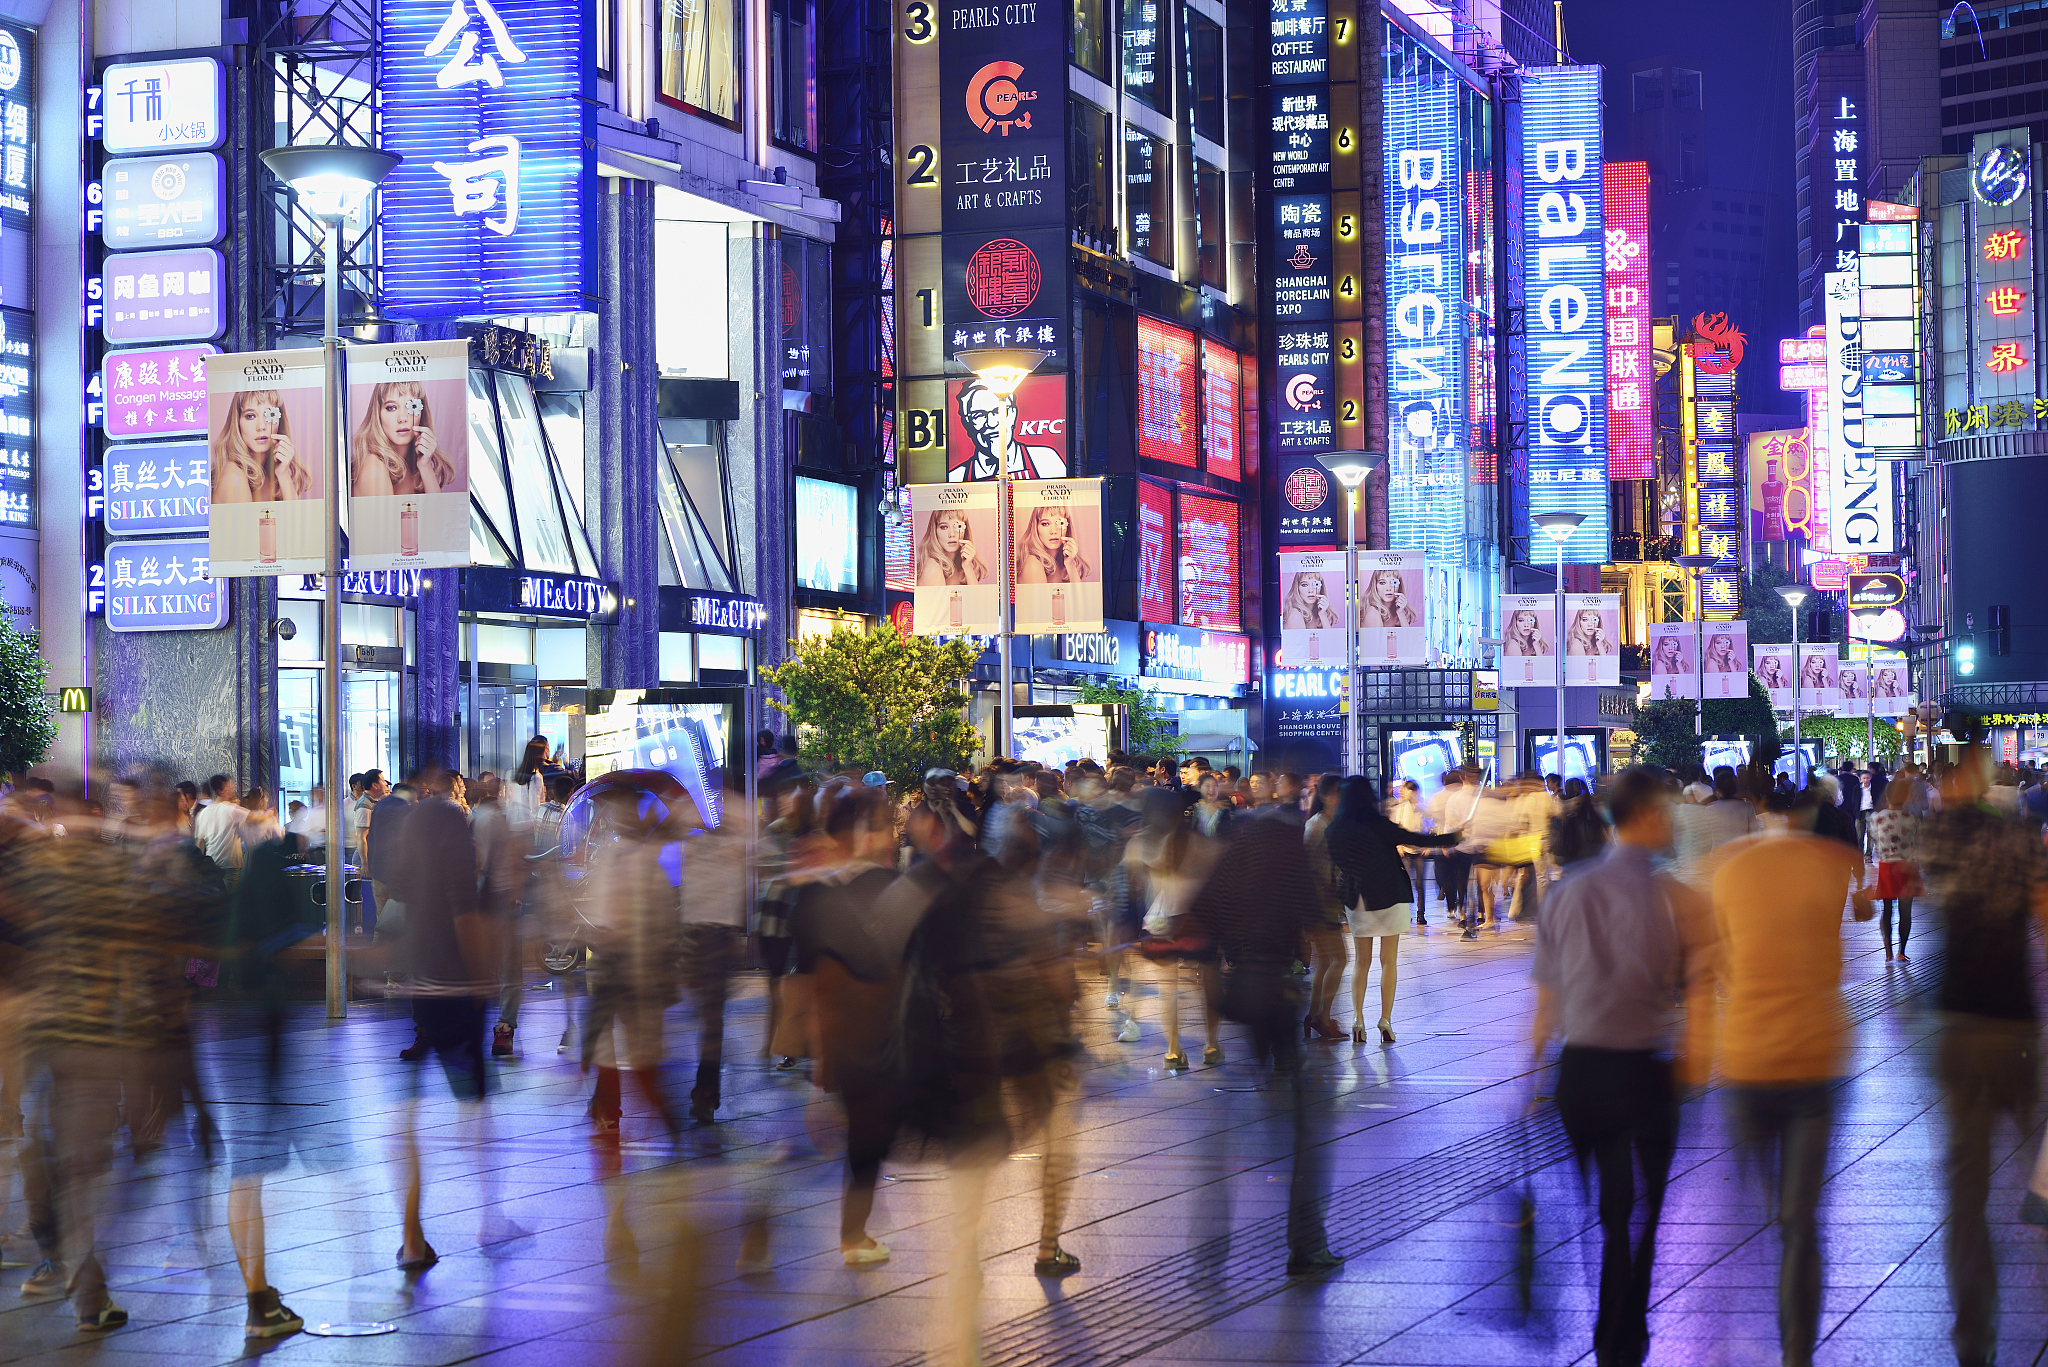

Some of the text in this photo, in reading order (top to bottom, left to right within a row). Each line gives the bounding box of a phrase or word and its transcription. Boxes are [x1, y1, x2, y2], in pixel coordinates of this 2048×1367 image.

[905, 1, 932, 41] 3
[952, 2, 1037, 30] PEARLS CITY
[1272, 16, 1326, 37] 咖啡餐厅
[1335, 18, 1347, 40] 7
[1272, 40, 1314, 56] COFFEE
[1272, 58, 1326, 75] RESTAURANT
[996, 91, 1038, 103] PEARLS
[1282, 94, 1318, 113] 新世界
[158, 121, 206, 142] 小火锅
[1272, 113, 1328, 132] 现代珍藏品
[1289, 132, 1313, 149] 中心
[1338, 127, 1350, 148] 6
[907, 145, 935, 184] 2
[1273, 150, 1309, 161] NEW WORLD
[955, 154, 1051, 185] 工艺礼品
[1273, 162, 1330, 175] CONTEMPORARY ART
[1273, 177, 1295, 188] CENTER
[1833, 97, 1860, 273] 上海置地广场
[957, 189, 1042, 210] ART & CRAFTS
[1281, 202, 1322, 225] 陶瓷
[1869, 204, 1896, 220] 新世界
[157, 227, 183, 239] BBQ
[1283, 228, 1321, 239] 精品商场
[1339, 215, 1352, 237] 5
[114, 270, 211, 300] 网鱼网咖
[1275, 275, 1327, 288] SHANGHAI
[1340, 275, 1353, 296] 4
[1276, 288, 1330, 302] PORCELAIN
[1984, 230, 2024, 372] 新世界
[915, 288, 935, 327] 1
[1276, 304, 1302, 315] EXPO
[952, 325, 1056, 348] 新世界銀樓
[1278, 331, 1329, 351] 珍珠城
[393, 349, 421, 357] PRADA
[1341, 338, 1354, 359] 3
[1609, 284, 1640, 411] 中国联通
[385, 355, 429, 367] CANDY
[389, 365, 426, 373] FLORALE
[1278, 352, 1330, 366] PEARLS CITY
[114, 356, 207, 390] 康骏养生
[243, 364, 286, 376] CANDY
[114, 389, 206, 406] Congen Massage
[124, 404, 199, 427] 推拿足道
[1342, 400, 1356, 421] 2
[908, 409, 944, 448] B1
[1019, 418, 1065, 436] KFC
[1280, 419, 1331, 435] 工艺礼品
[1281, 436, 1330, 447] ART & CRAFTS
[110, 459, 209, 493] 真丝大王
[1533, 468, 1601, 483] 班尼路
[938, 492, 970, 500] CANDY
[1040, 488, 1073, 496] CANDY
[110, 496, 209, 520] SILK KING
[112, 556, 214, 589] 真丝大王
[112, 593, 212, 615] SILK KING
[525, 577, 608, 614] ME&CITY
[696, 597, 764, 630] ME&CITY
[1065, 632, 1119, 665] Bershka
[1274, 672, 1328, 698] PEARL
